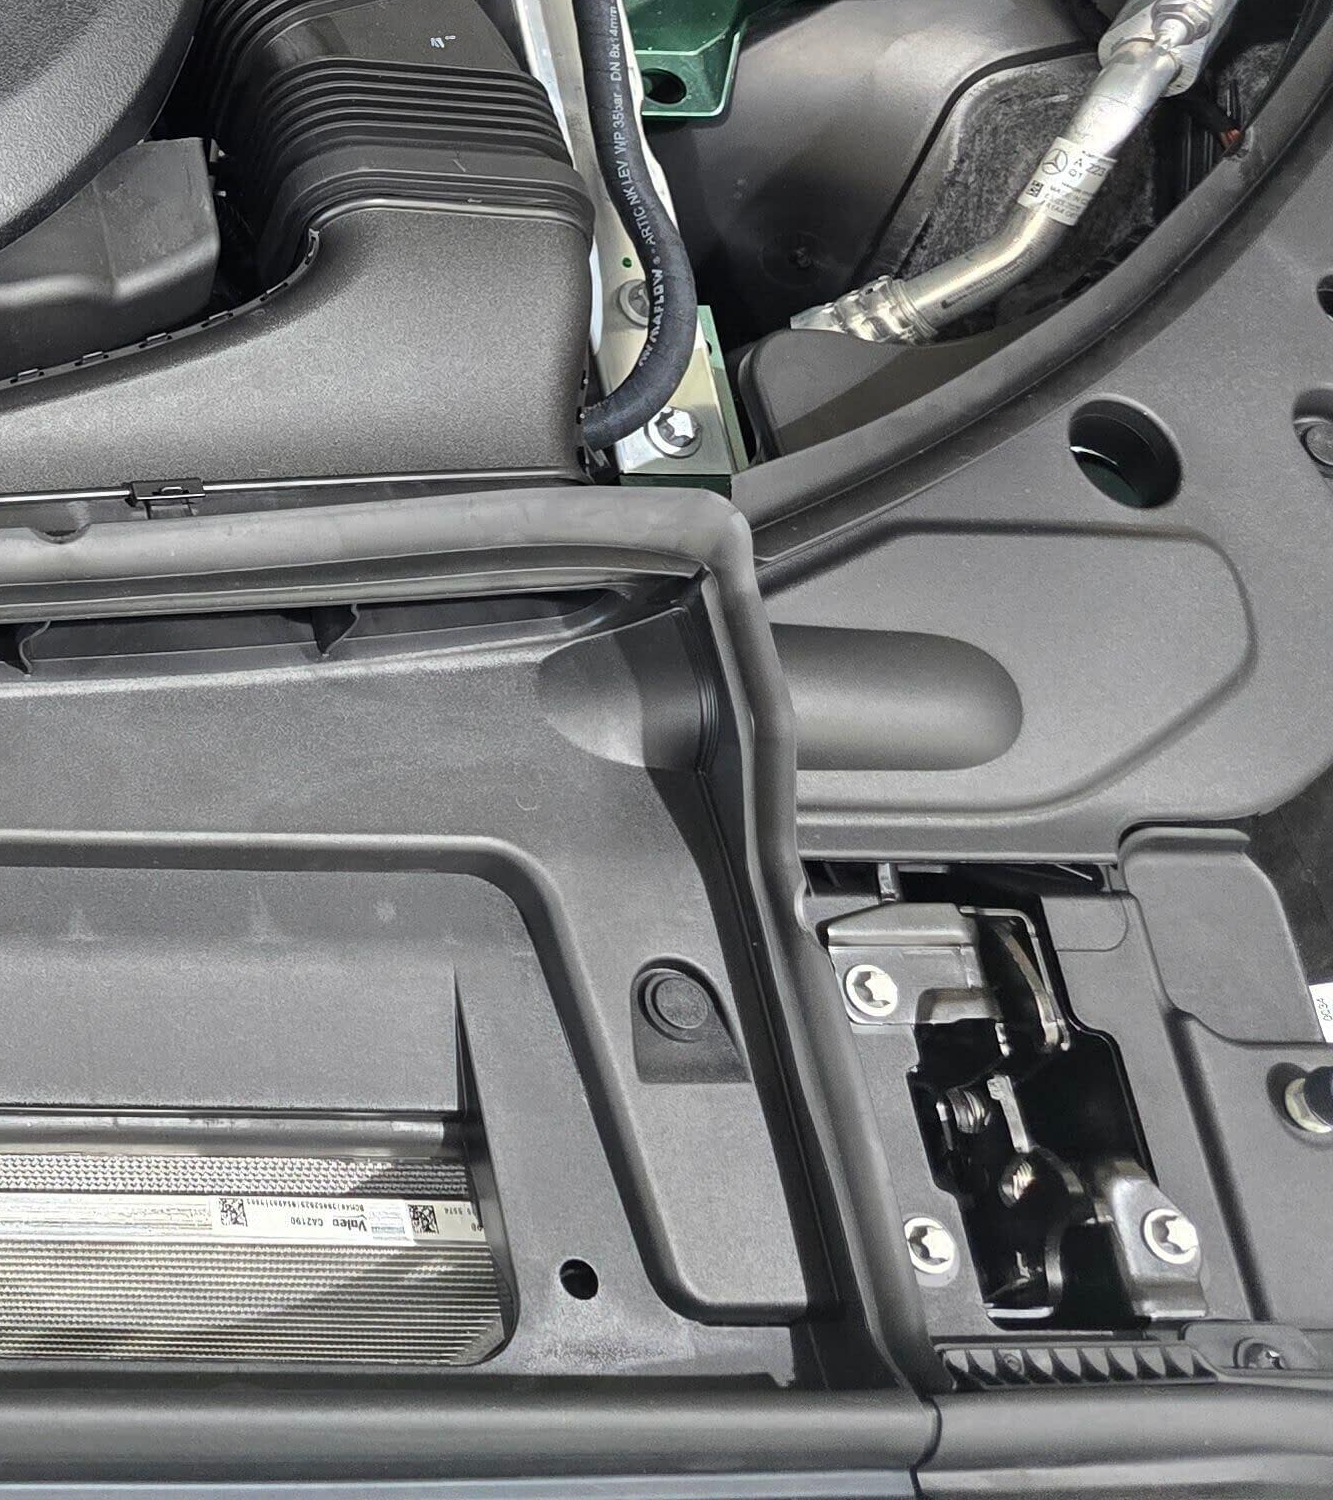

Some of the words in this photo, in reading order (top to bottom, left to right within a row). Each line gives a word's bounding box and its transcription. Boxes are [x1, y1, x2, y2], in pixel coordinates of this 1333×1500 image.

[609, 61, 623, 82] DN
[613, 132, 628, 157] WP
[622, 186, 641, 207] NK
[635, 206, 656, 246] ARTIC
[332, 1215, 368, 1232] Valeo
